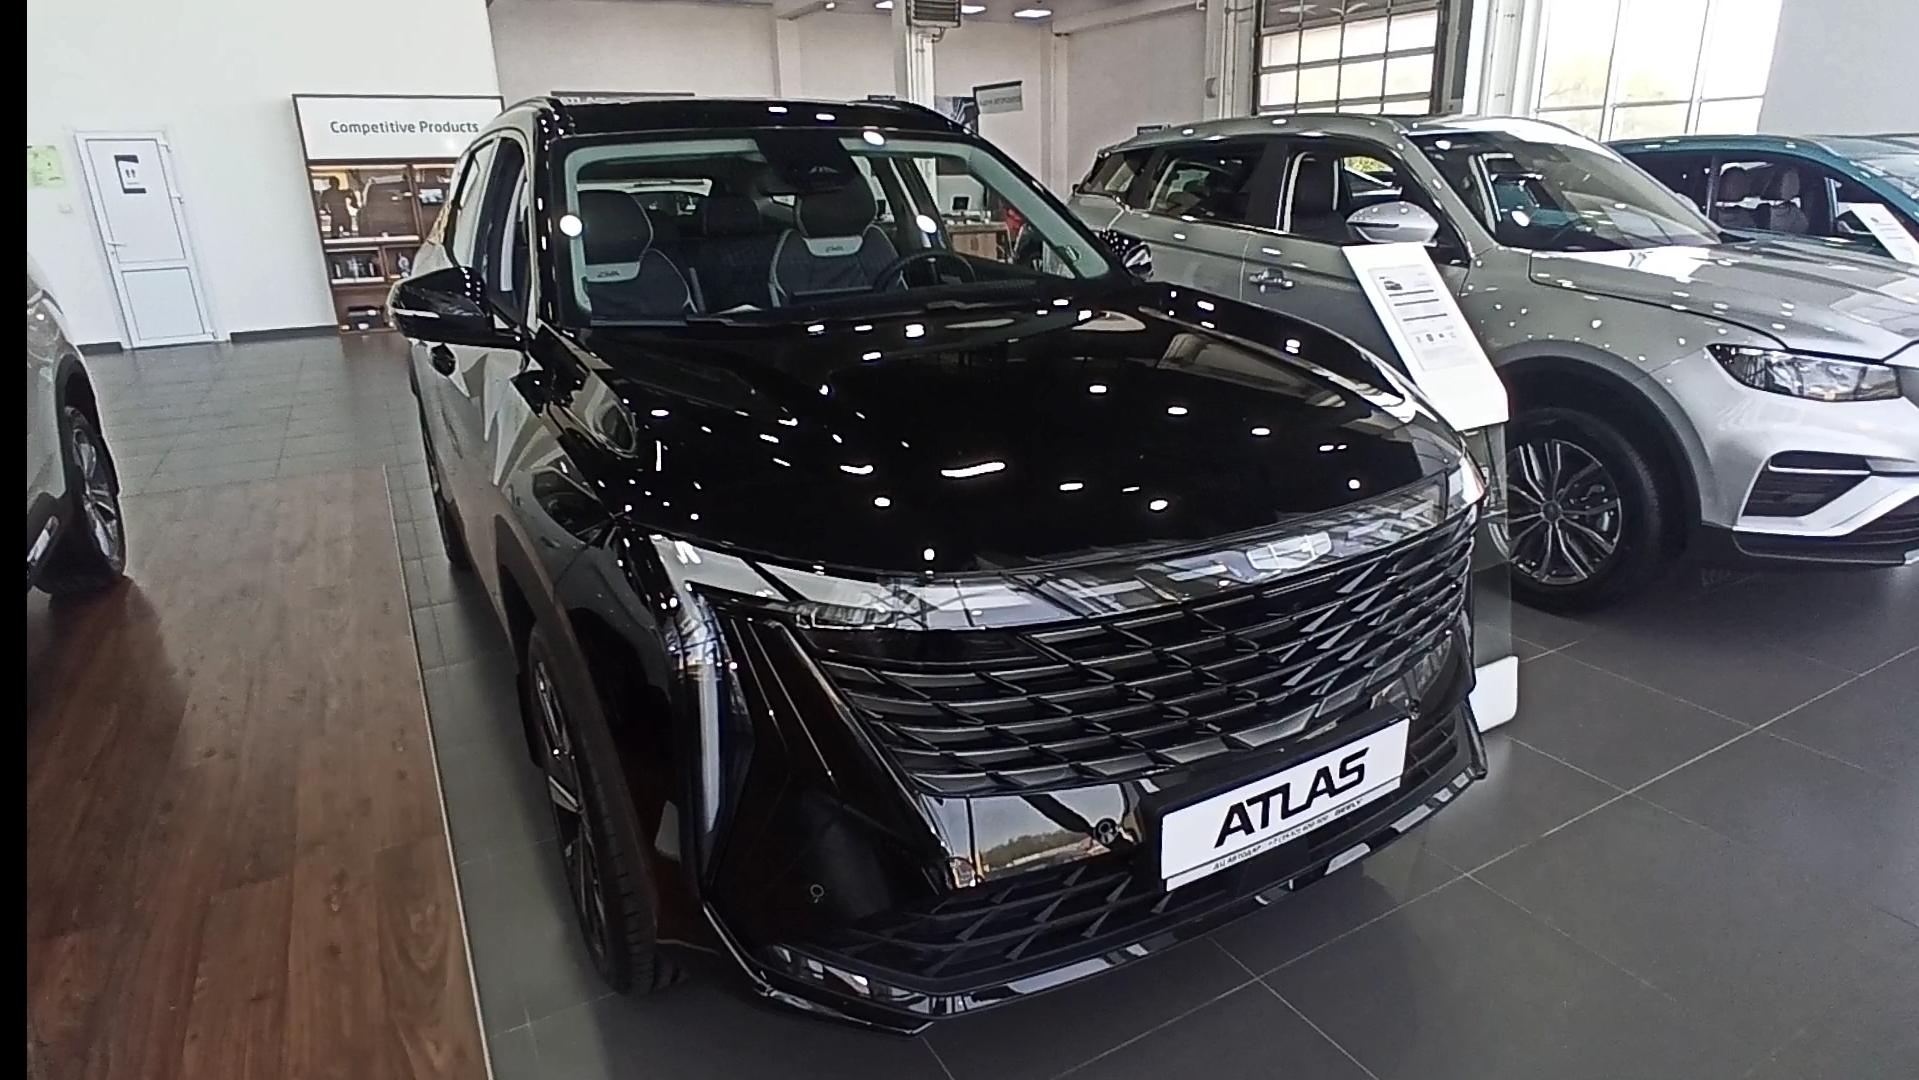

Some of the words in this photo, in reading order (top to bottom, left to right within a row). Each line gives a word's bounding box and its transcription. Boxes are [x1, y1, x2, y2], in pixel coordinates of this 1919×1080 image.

[330, 120, 416, 136] Competitive
[419, 120, 479, 133] Products
[1213, 746, 1370, 849] ATLAS
